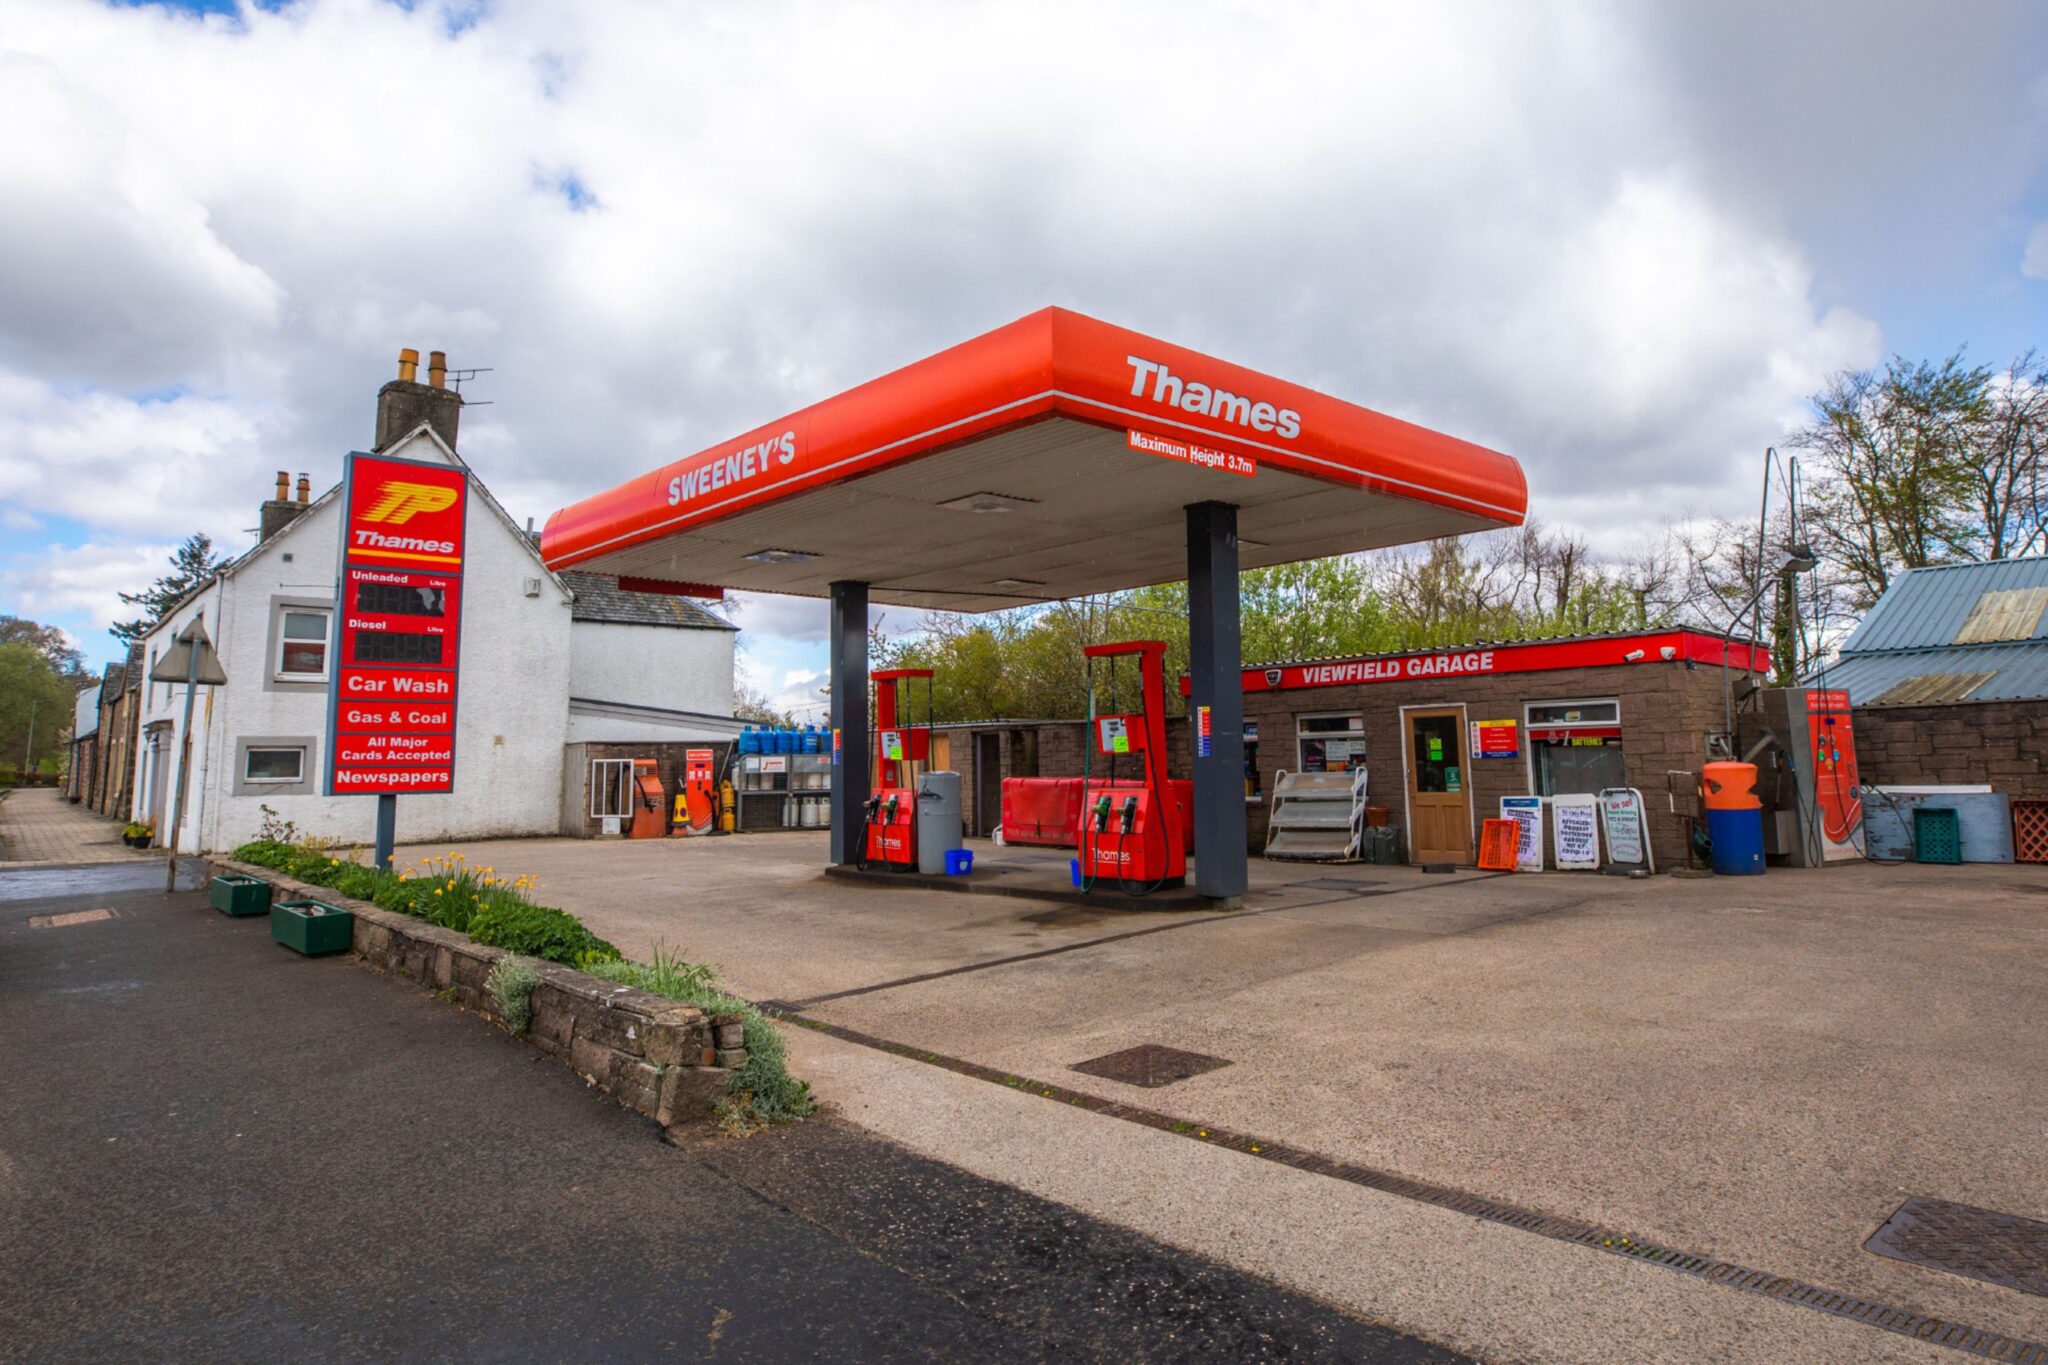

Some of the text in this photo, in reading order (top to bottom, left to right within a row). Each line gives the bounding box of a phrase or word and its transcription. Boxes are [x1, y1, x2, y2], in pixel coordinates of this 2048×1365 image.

[1127, 354, 1301, 440] Thames
[1130, 431, 1253, 473] Maximum Height 3.7m
[667, 430, 796, 507] SWEENEY'S
[355, 530, 455, 554] Thames
[352, 570, 447, 587] Unleaded Litre
[349, 618, 387, 630] Diesel
[1302, 651, 1495, 684] VIEWFIELD GARAGE
[348, 675, 449, 693] Car Wash
[347, 710, 447, 724] Gas & Coal
[367, 737, 428, 749] All Major
[341, 750, 451, 762] Cards Accepted
[337, 770, 449, 785] Newspapers
